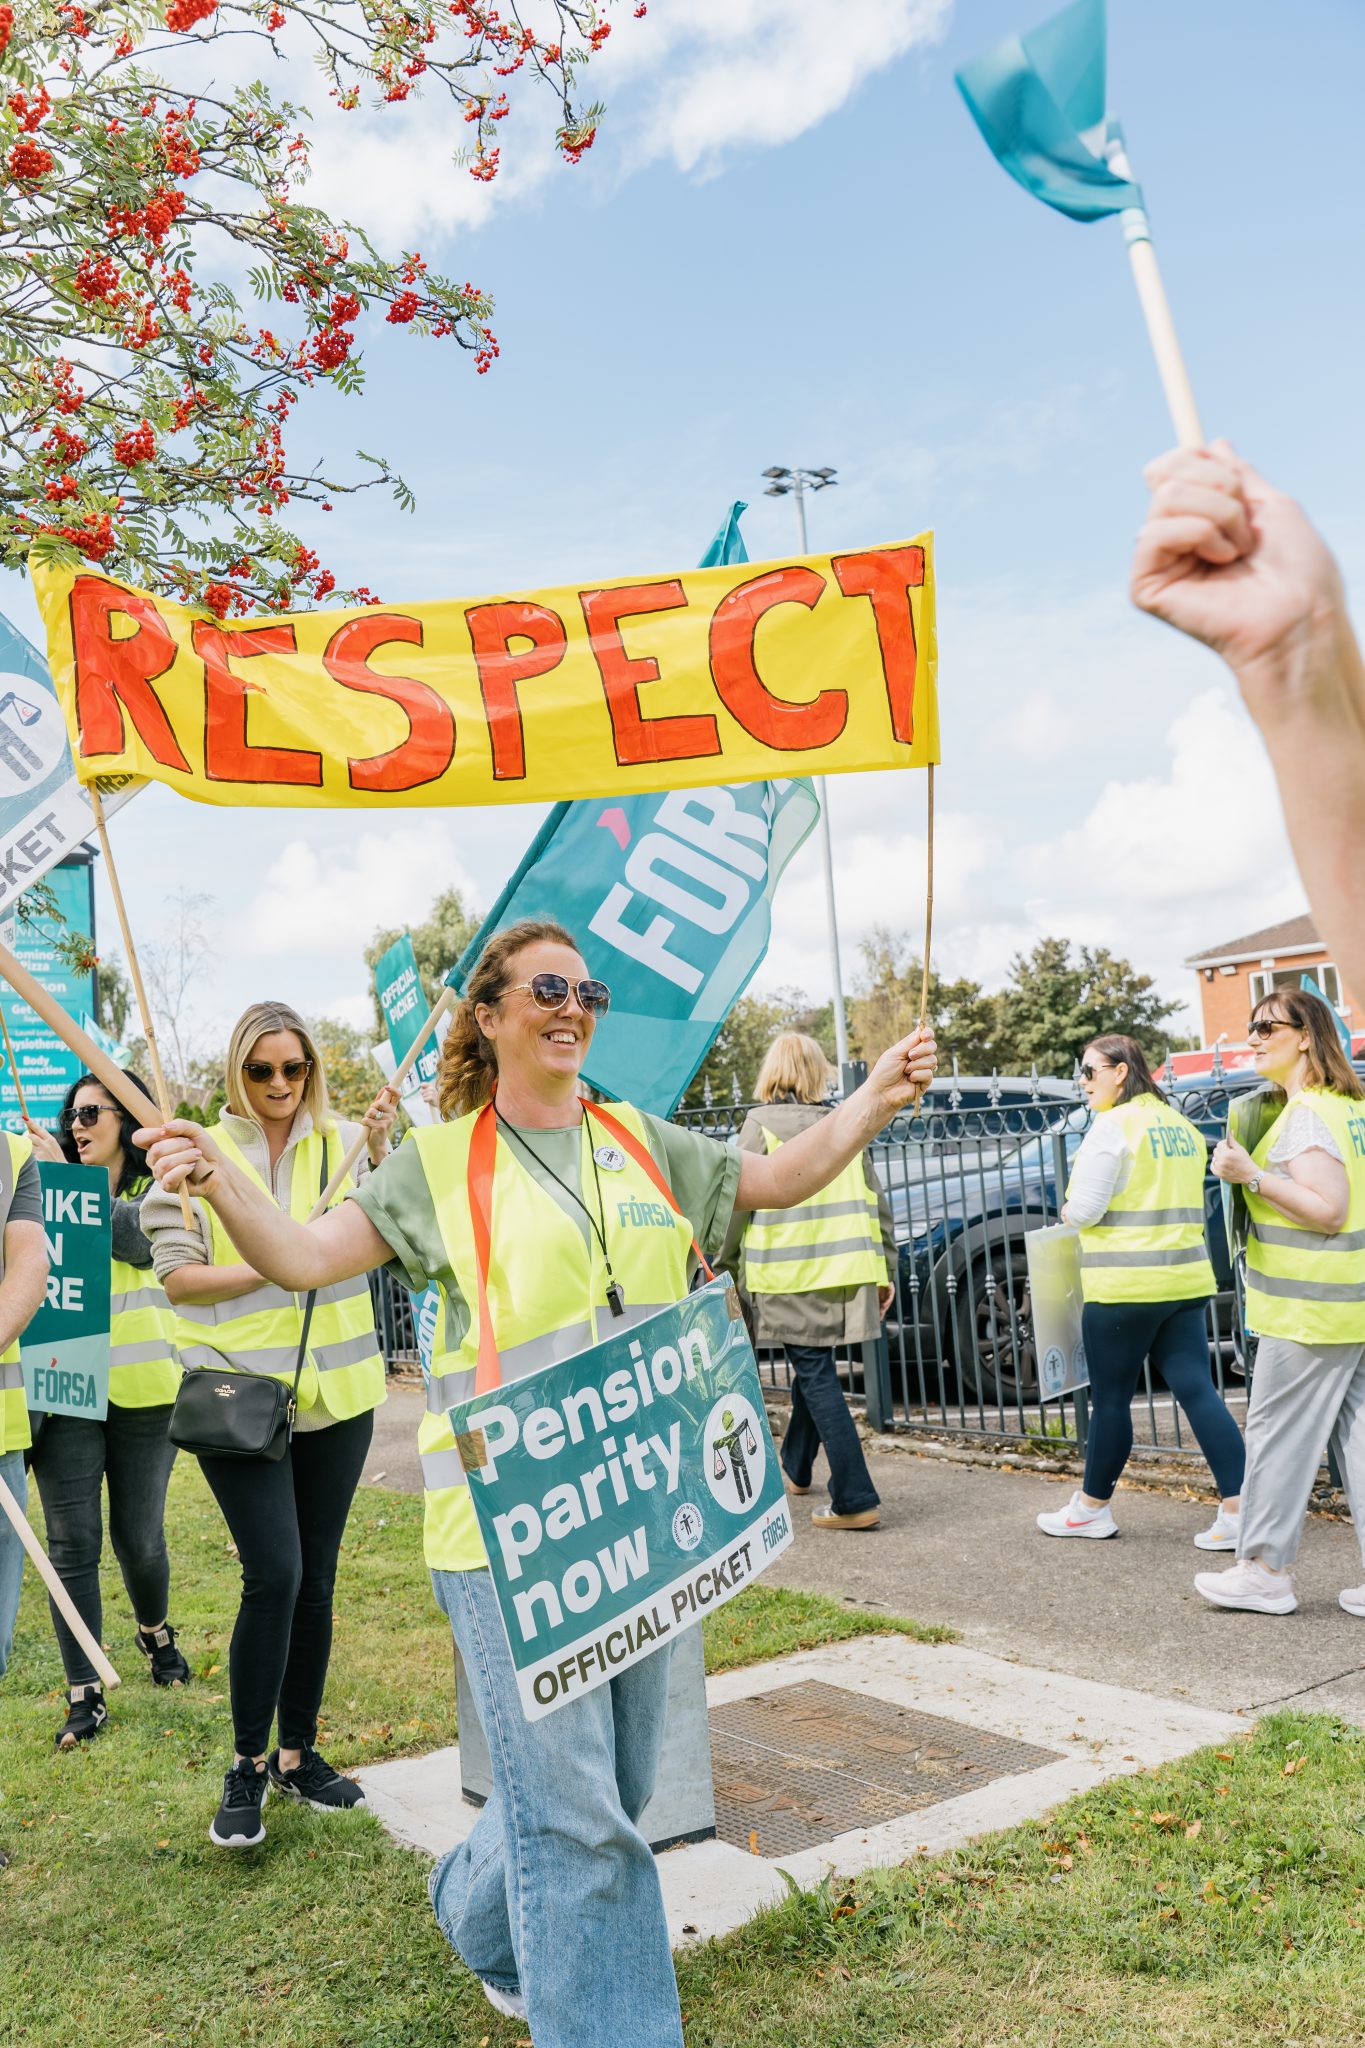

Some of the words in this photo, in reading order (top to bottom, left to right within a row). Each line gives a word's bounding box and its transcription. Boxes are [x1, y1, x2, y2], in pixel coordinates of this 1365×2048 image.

[69, 546, 925, 794] RESPECT
[381, 966, 417, 1008] OFFICIAL
[389, 987, 419, 1025] PICKET
[23, 1056, 50, 1067] Body
[2, 1085, 37, 1096] DULIN
[1147, 1116, 1197, 1158] FÓRSA
[41, 1189, 102, 1226] IKE
[617, 1195, 676, 1229] FÓRSA
[44, 1232, 63, 1266] N
[40, 1276, 84, 1311] RE
[34, 1358, 97, 1409] FÓRSA
[466, 1327, 713, 1486] Pension
[493, 1421, 681, 1581] parity
[761, 1516, 789, 1554] FÓRSA
[512, 1526, 650, 1642] now
[532, 1606, 671, 1706] OFFICIAL
[670, 1540, 753, 1623] PICKET
